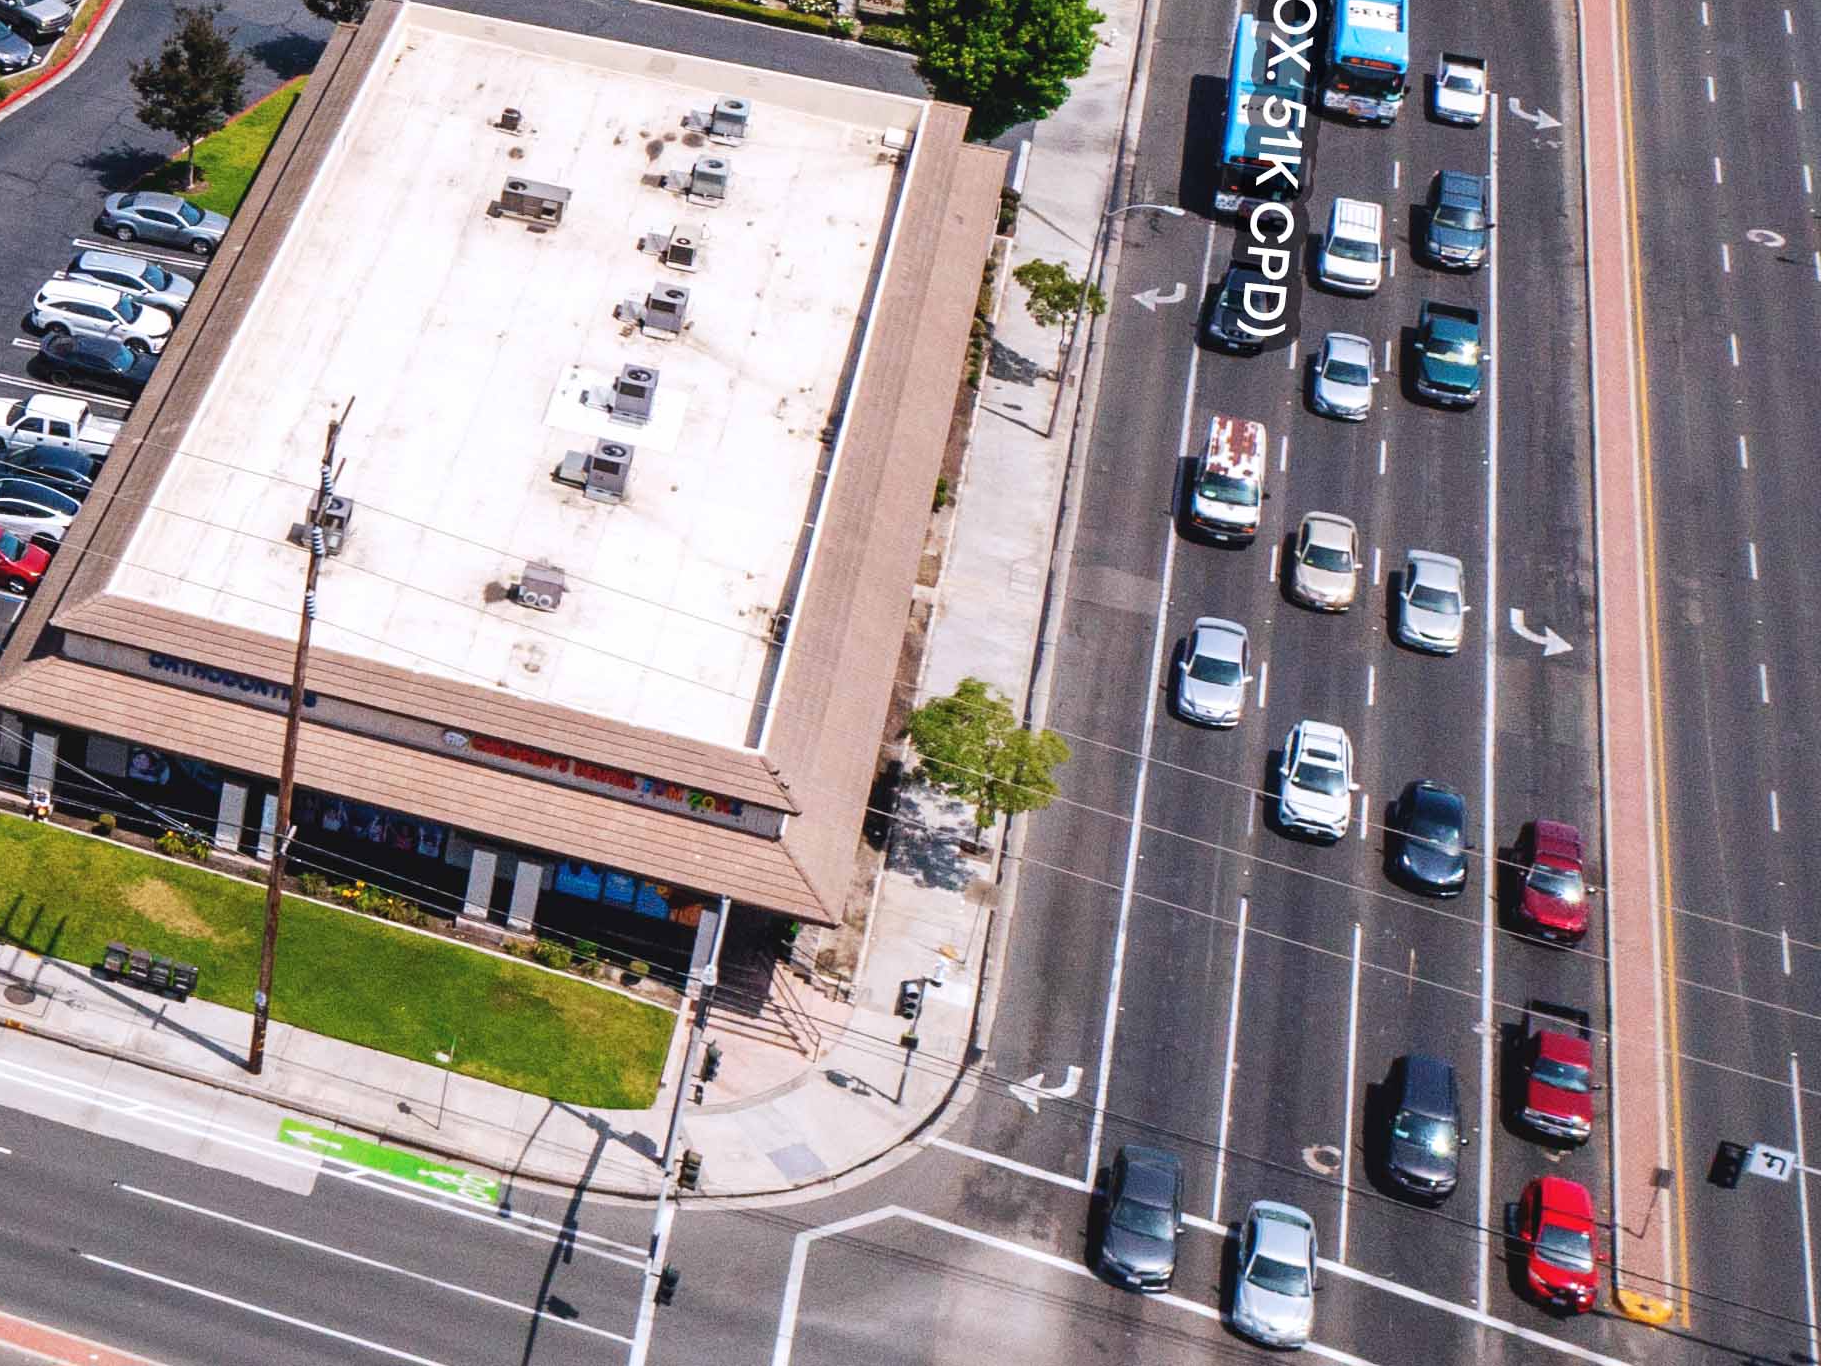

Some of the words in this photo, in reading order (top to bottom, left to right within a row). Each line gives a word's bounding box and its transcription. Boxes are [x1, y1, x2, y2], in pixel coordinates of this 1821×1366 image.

[149, 651, 318, 709] ORTHODONTIS
[640, 777, 683, 803] FUN
[686, 790, 744, 817] ZONE
